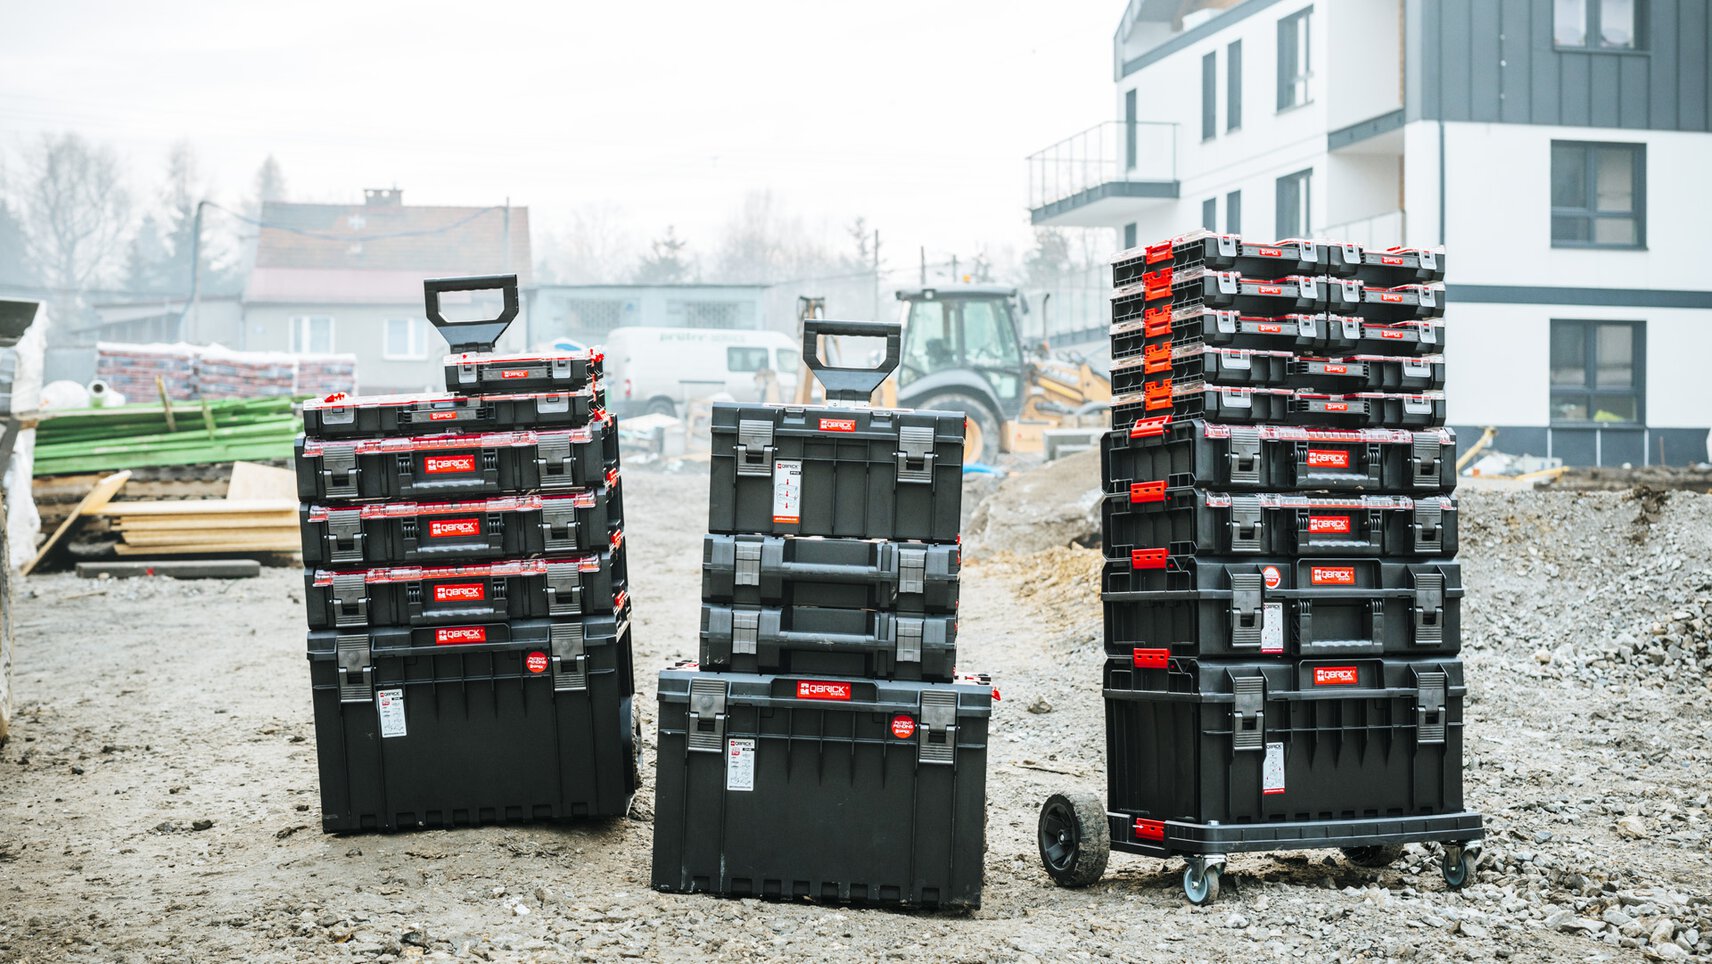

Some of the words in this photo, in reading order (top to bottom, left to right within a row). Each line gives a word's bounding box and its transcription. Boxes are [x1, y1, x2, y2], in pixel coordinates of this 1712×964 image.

[436, 459, 470, 468] QBRICK
[1316, 454, 1344, 463] QBRICK
[441, 522, 474, 532] QBRICK
[1318, 519, 1346, 529] QBRICK
[1321, 570, 1350, 580] QBRICK
[445, 587, 479, 597] QBRICK
[447, 629, 480, 639] QBRICK
[1324, 670, 1352, 680] QBRICK
[810, 684, 845, 694] QBRICK
